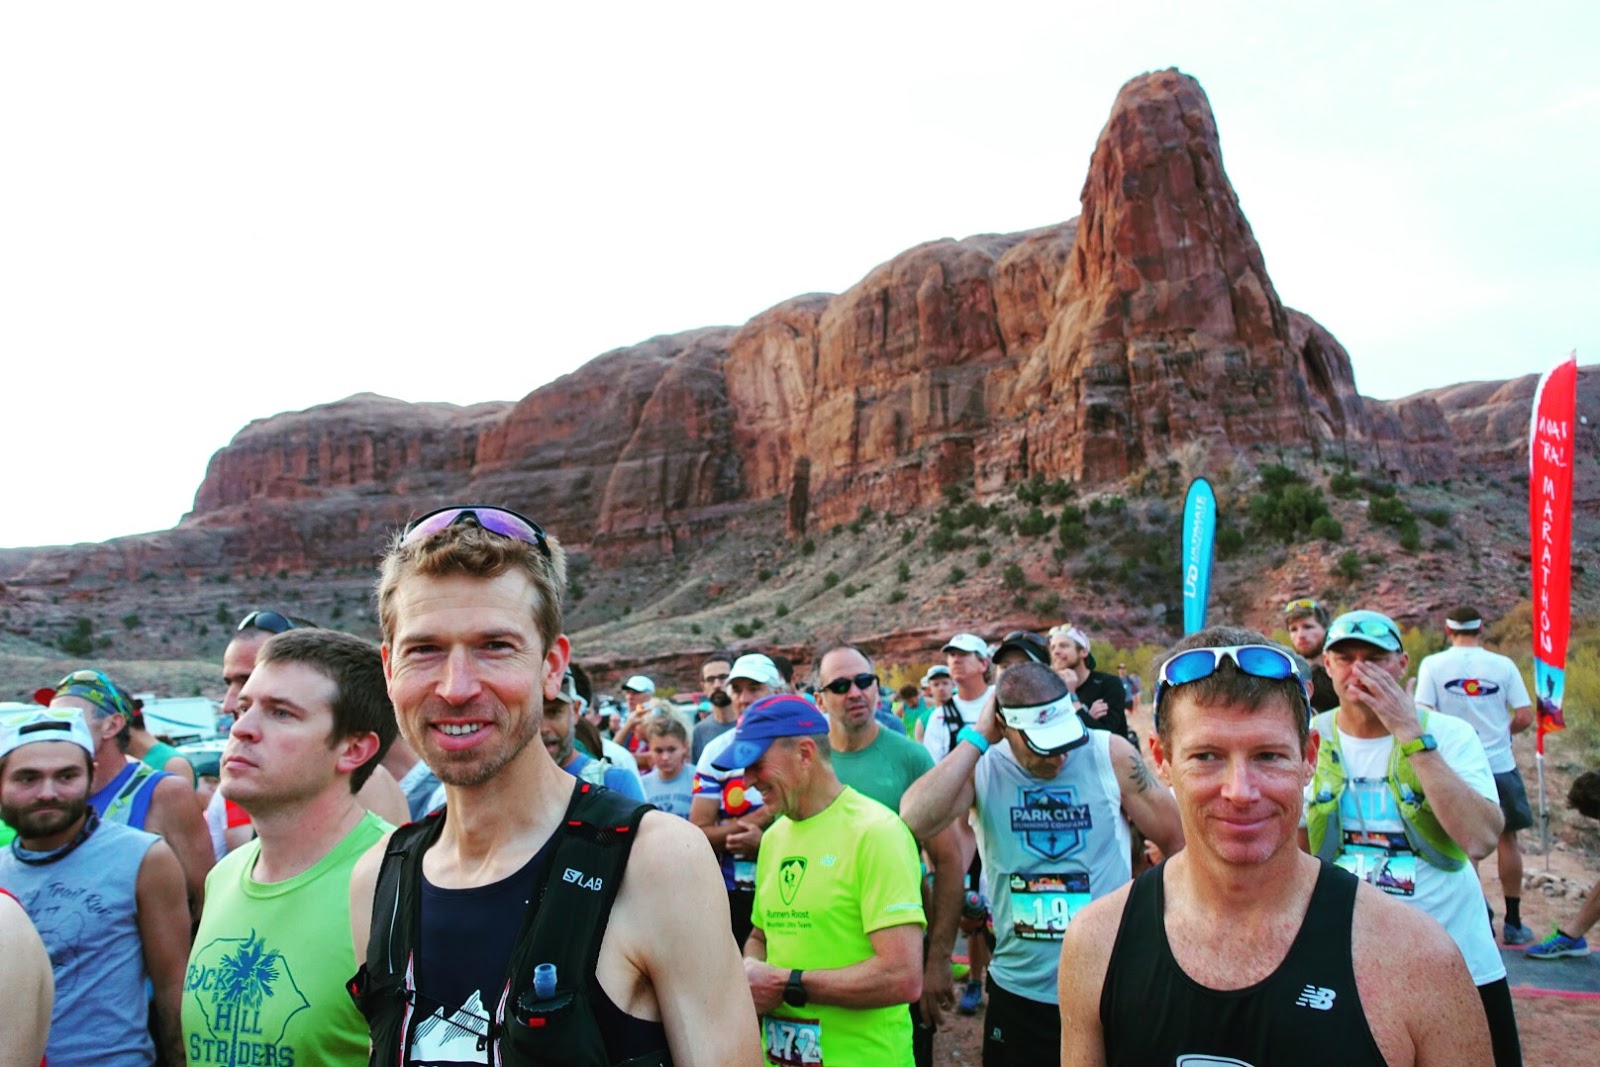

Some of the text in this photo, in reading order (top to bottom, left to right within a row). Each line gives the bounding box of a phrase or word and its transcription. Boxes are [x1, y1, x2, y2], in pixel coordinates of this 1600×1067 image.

[1540, 475, 1555, 653] MARATHON
[1012, 806, 1087, 821] PARK CITY
[1032, 896, 1069, 931] 19
[767, 1022, 823, 1064] 172
